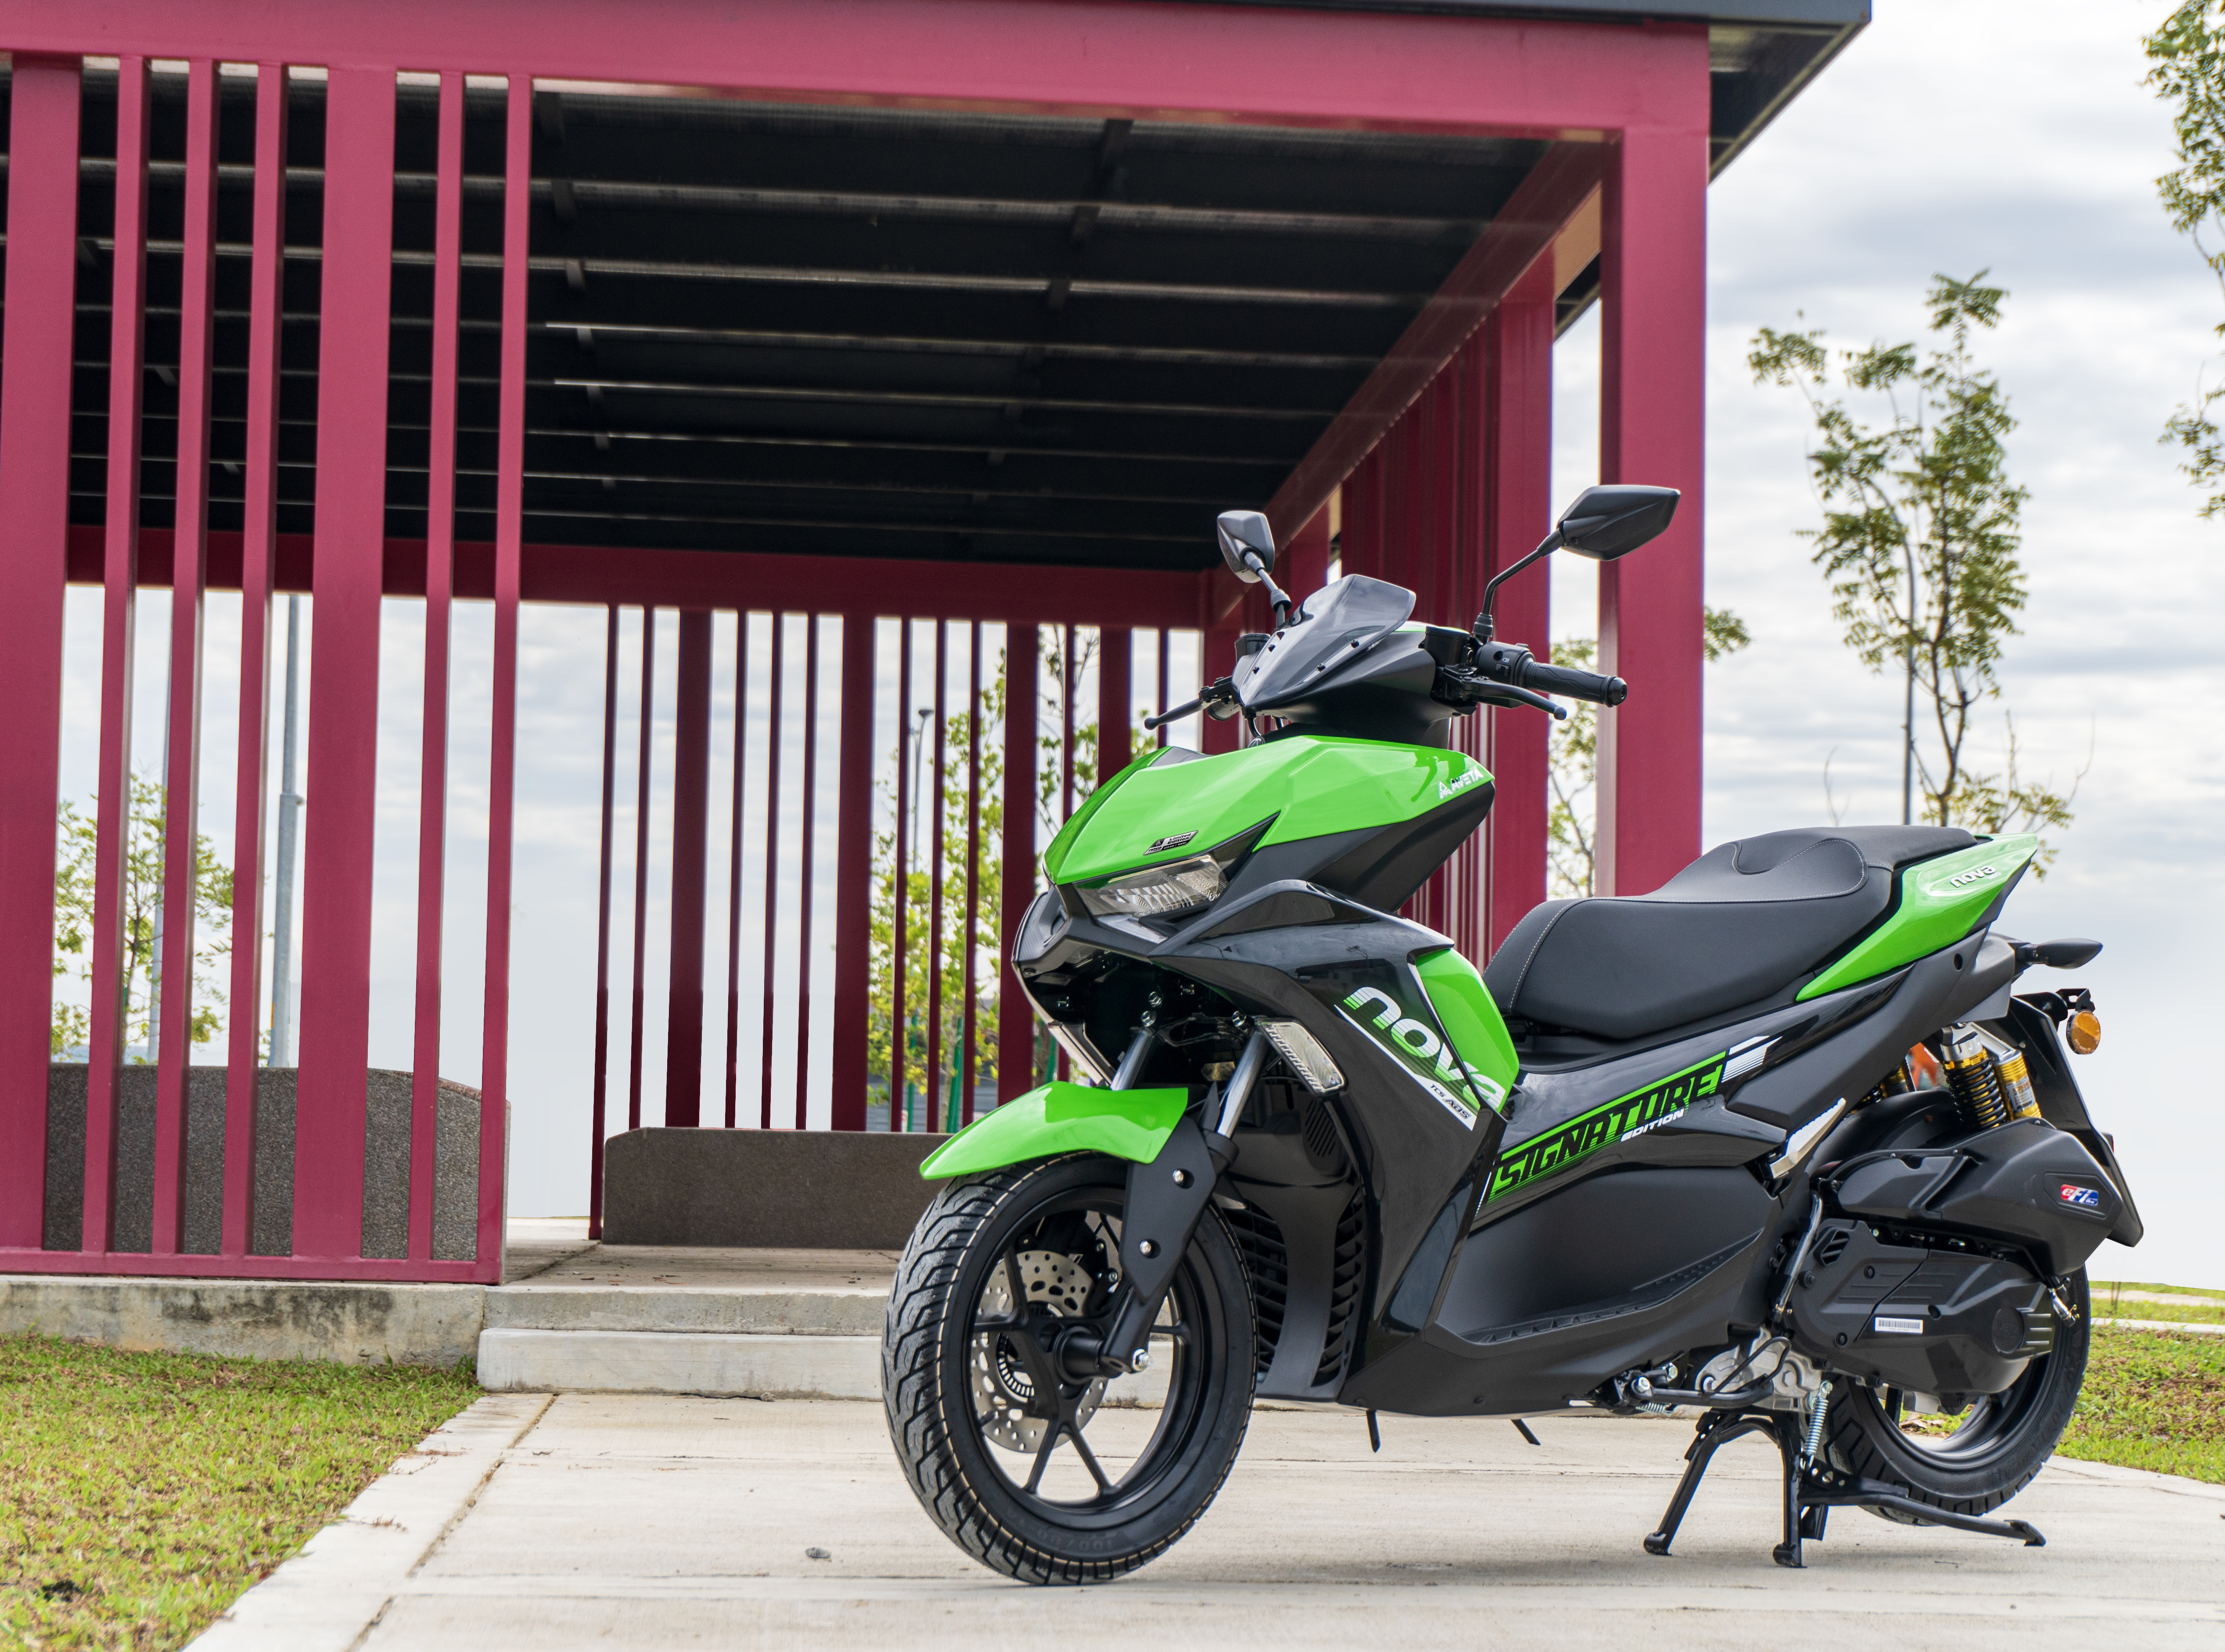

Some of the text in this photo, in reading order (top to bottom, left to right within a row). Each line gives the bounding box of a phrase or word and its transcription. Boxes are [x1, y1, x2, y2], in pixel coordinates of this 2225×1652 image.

[1450, 768, 1484, 791] AVETA
[1950, 866, 1996, 888] nova
[1431, 1084, 1446, 1097] TCS
[1442, 1099, 1471, 1119] ABS
[1493, 1065, 1722, 1193] SIGNATURE
[1620, 1108, 1685, 1142] EDITION
